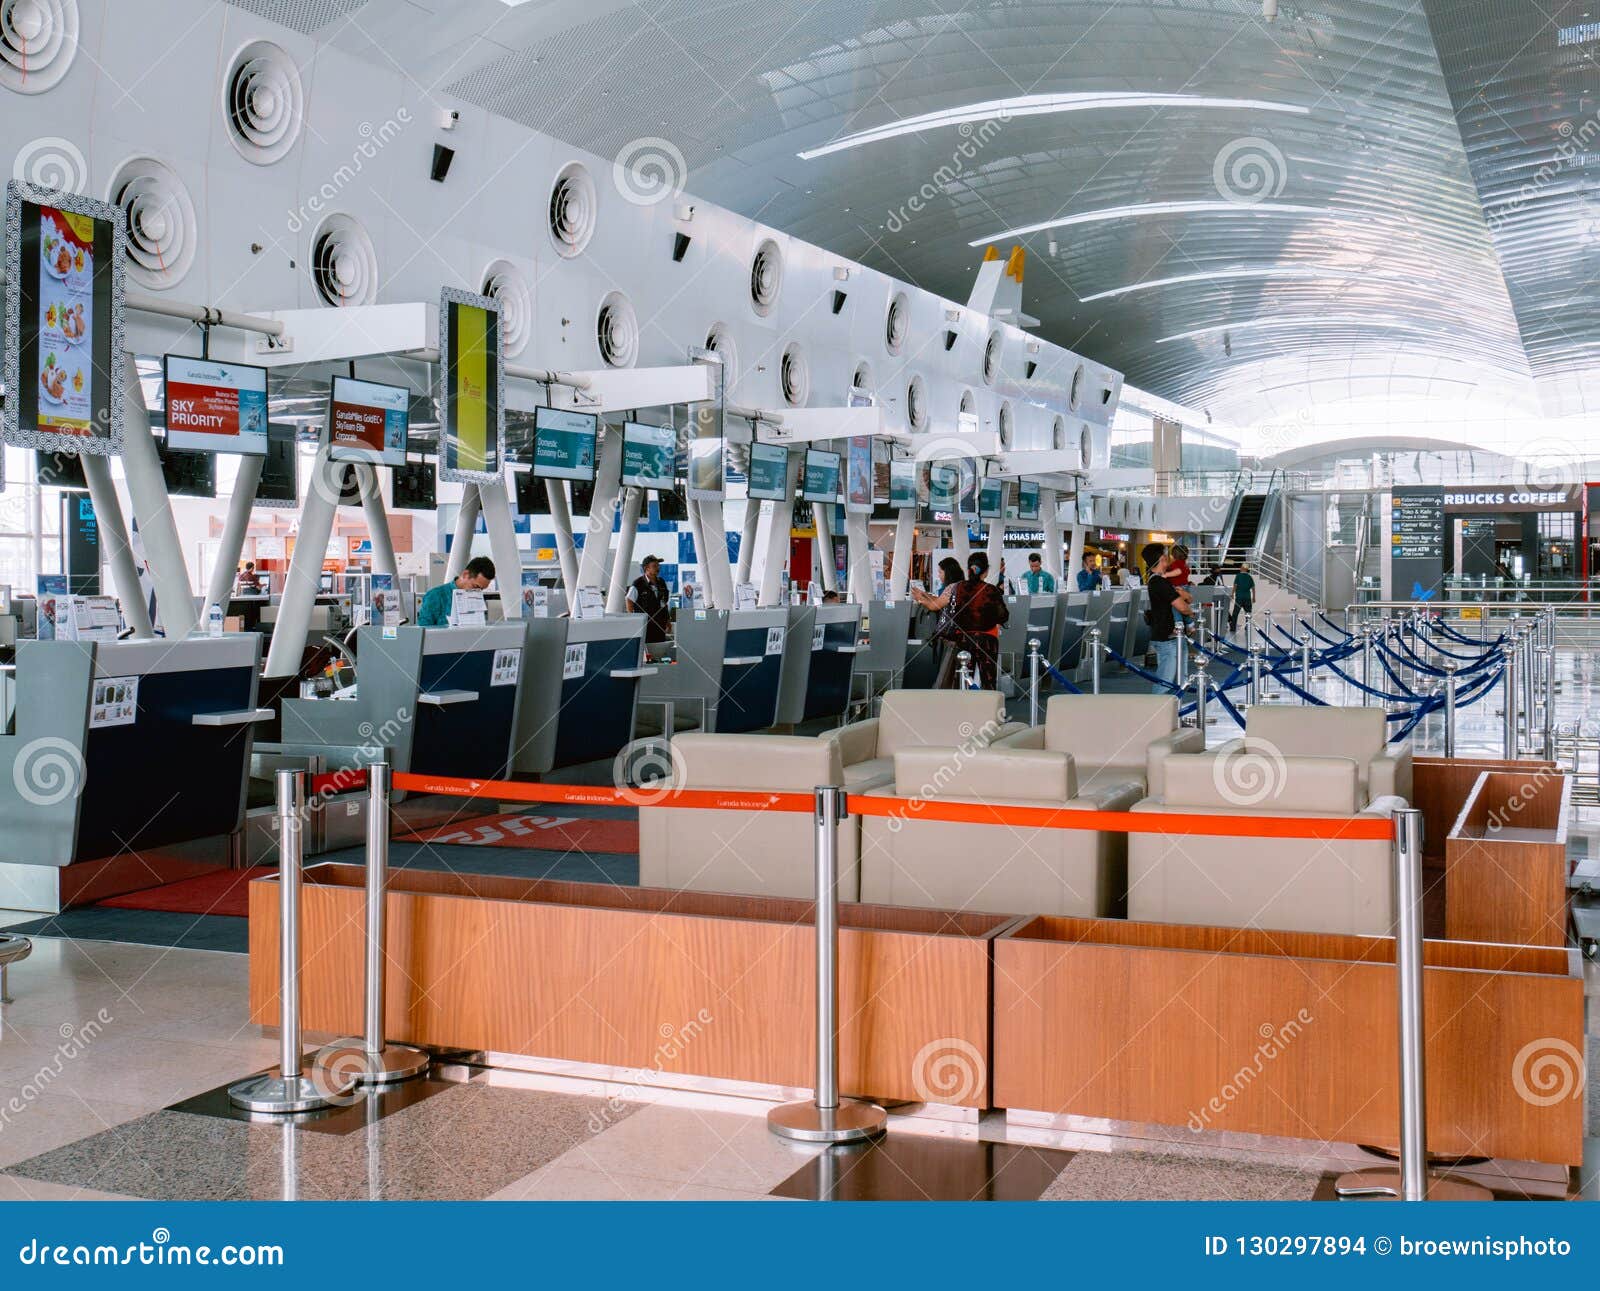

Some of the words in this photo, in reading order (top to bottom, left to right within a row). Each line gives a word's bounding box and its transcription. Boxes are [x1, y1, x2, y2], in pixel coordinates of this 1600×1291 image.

[171, 399, 195, 412] SKY
[171, 412, 224, 428] PRIORITY
[1508, 492, 1566, 504] COFFEE
[1009, 533, 1030, 541] KHAS
[424, 783, 444, 792] Garuda
[565, 792, 585, 801] Garuda
[717, 799, 739, 807] Garuda
